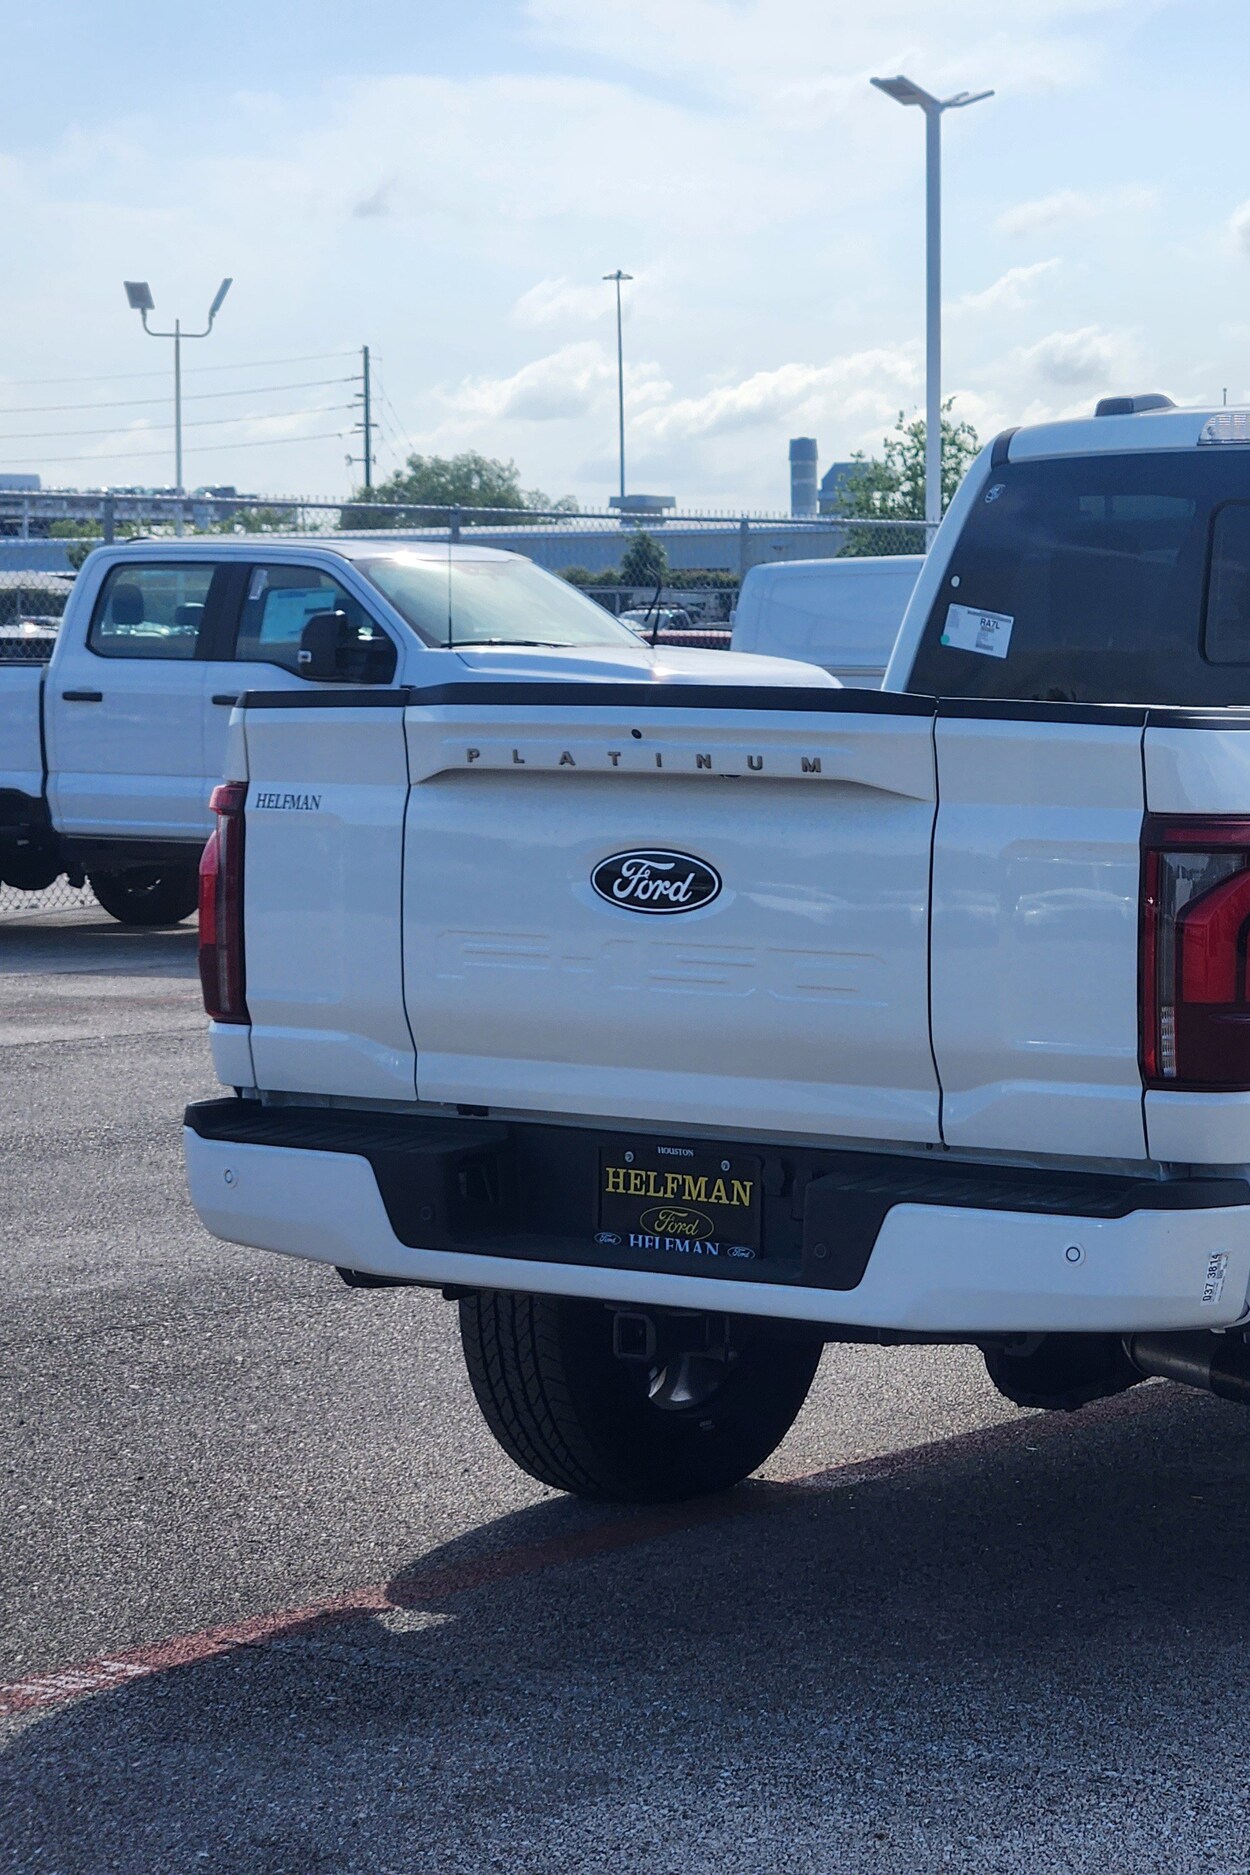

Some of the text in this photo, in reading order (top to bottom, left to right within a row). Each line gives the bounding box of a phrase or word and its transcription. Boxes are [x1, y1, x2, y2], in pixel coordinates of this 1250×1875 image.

[465, 748, 822, 774] PLATINUM
[256, 793, 322, 811] HELFMAN
[612, 858, 696, 903] Ford
[657, 1146, 694, 1157] HOUSTON
[605, 1167, 753, 1207] HELFMAN
[654, 1209, 699, 1236] Ford
